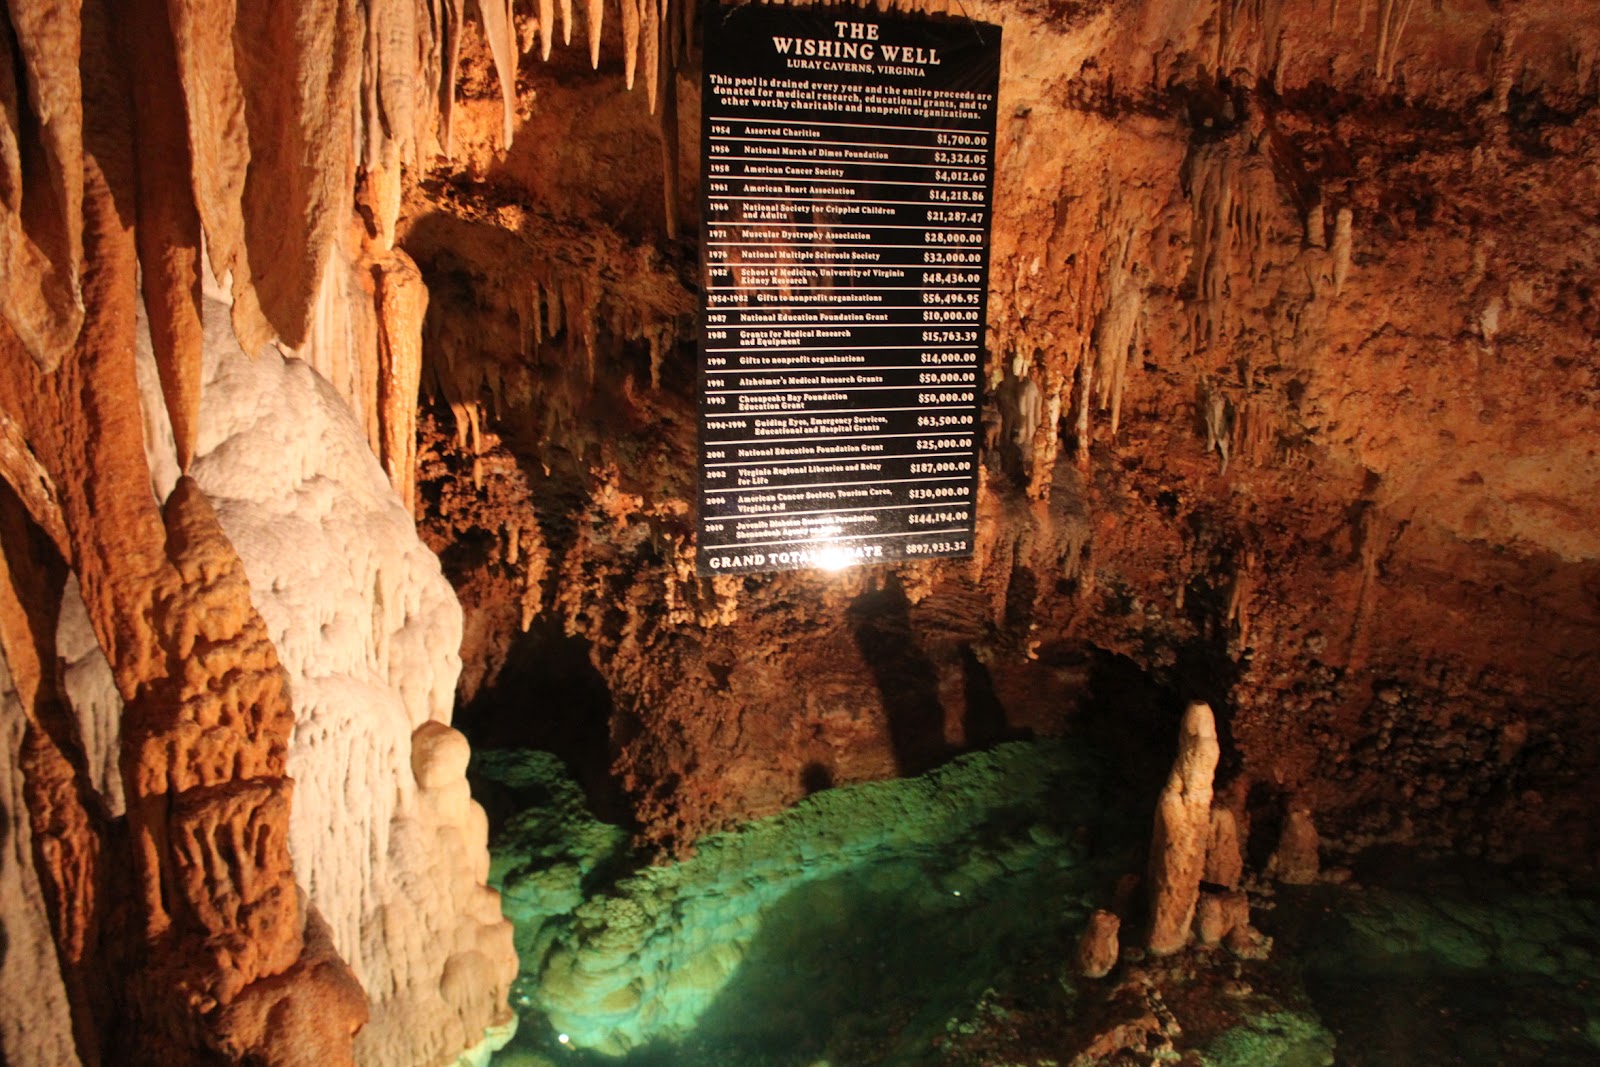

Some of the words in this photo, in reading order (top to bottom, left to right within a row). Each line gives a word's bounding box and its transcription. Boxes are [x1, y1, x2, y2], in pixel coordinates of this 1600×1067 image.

[834, 21, 879, 40] THE
[772, 37, 874, 60] WISHING
[880, 45, 940, 64] WELL
[787, 59, 822, 69] LURAY
[823, 62, 875, 74] CAVERNS,
[877, 65, 925, 76] VIRGINIA
[710, 74, 732, 85] This
[735, 77, 757, 89] pool
[759, 77, 768, 87] is
[770, 78, 809, 89] drained
[811, 83, 839, 93] every
[841, 85, 862, 95] year
[865, 85, 882, 94] and
[884, 86, 900, 95] the
[902, 88, 932, 97] entire
[934, 91, 974, 100] proceeds
[713, 85, 755, 96] donated
[758, 88, 773, 97] for
[776, 90, 815, 99] medical
[817, 93, 862, 105] research,
[865, 95, 921, 106] educational
[923, 100, 956, 110] grants,
[959, 101, 976, 109] and
[721, 97, 749, 106] other
[752, 99, 789, 110] worthy
[791, 100, 843, 111] charitable
[845, 104, 862, 112] and
[865, 106, 911, 115] nonprofit
[913, 109, 981, 119] organizations.
[712, 126, 730, 134] 1954
[745, 127, 781, 136] Assorted
[783, 128, 820, 137] Charities
[937, 134, 987, 146] $1,700.00
[711, 145, 730, 153] 1956
[744, 146, 780, 154] National
[782, 147, 807, 156] March
[819, 149, 842, 157] Dimes
[844, 150, 888, 159] Foundation
[934, 153, 986, 164] $2,324.05
[711, 164, 730, 173] 1958
[744, 165, 783, 174] American
[785, 166, 813, 175] Cancer
[815, 167, 844, 177] Society
[935, 171, 985, 182] $4,012.60
[743, 184, 783, 193] American
[785, 185, 807, 193] Heart
[809, 186, 855, 195] Association
[929, 190, 984, 201] $14,218.86
[743, 203, 778, 212] National
[780, 204, 810, 213] Society
[826, 205, 860, 214] Crippled
[861, 206, 895, 214] Children
[927, 211, 983, 223] $21,287.47
[709, 230, 727, 238] 1971
[742, 230, 779, 238] Muscular
[782, 230, 823, 240] Dystrophy
[925, 233, 982, 244] $28,000.00
[779, 251, 813, 260] Multiple
[815, 251, 850, 259] Sclerosis
[851, 252, 880, 261] Society
[924, 252, 981, 263] $32,000.00
[769, 268, 778, 276] of
[780, 268, 818, 277] Medicine,
[820, 269, 861, 278] University
[873, 269, 904, 278] Virginia
[923, 273, 980, 284] $48,436.00
[741, 276, 770, 285] Kidney
[708, 294, 748, 303] 1954-1982
[789, 294, 828, 303] nonprofit
[829, 294, 882, 303] organizations
[923, 294, 979, 304] $56,496.95
[708, 315, 726, 323] 1987
[923, 311, 978, 322] $10,000.00
[740, 330, 768, 339] Grants
[922, 332, 977, 342] $15,763.39
[740, 337, 755, 346] and
[756, 336, 800, 346] Equipment
[772, 356, 810, 365] nonprofit
[811, 355, 865, 364] organizations
[921, 353, 976, 364] $14,000.00
[739, 376, 787, 386] Alzheimer's
[919, 373, 975, 384] $50,000.00
[739, 394, 786, 405] Chesapeake
[787, 394, 802, 402] Bay
[918, 393, 974, 404] $50,000.00
[739, 401, 780, 411] Education
[781, 400, 804, 409] Grant
[707, 421, 747, 429] 1994-1996
[755, 419, 787, 430] Guiding
[788, 418, 809, 428] Eyes,
[810, 418, 852, 428] Emergency
[917, 416, 973, 426] $63,500.00
[916, 439, 972, 450] $25,000.00
[738, 448, 773, 457] National
[775, 447, 815, 455] Education
[816, 445, 860, 453] Foundation
[738, 468, 772, 478] Virginia
[773, 466, 807, 476] Regional
[808, 465, 844, 473] Libraries
[910, 462, 970, 473] $187,000.00
[738, 495, 776, 503] American
[806, 491, 836, 499] Society,
[909, 487, 969, 499] $130,000.00
[706, 497, 726, 505] 2006
[908, 512, 968, 524] $144,194.00
[906, 541, 966, 554] $897,933.32
[709, 554, 765, 568] GRAND
